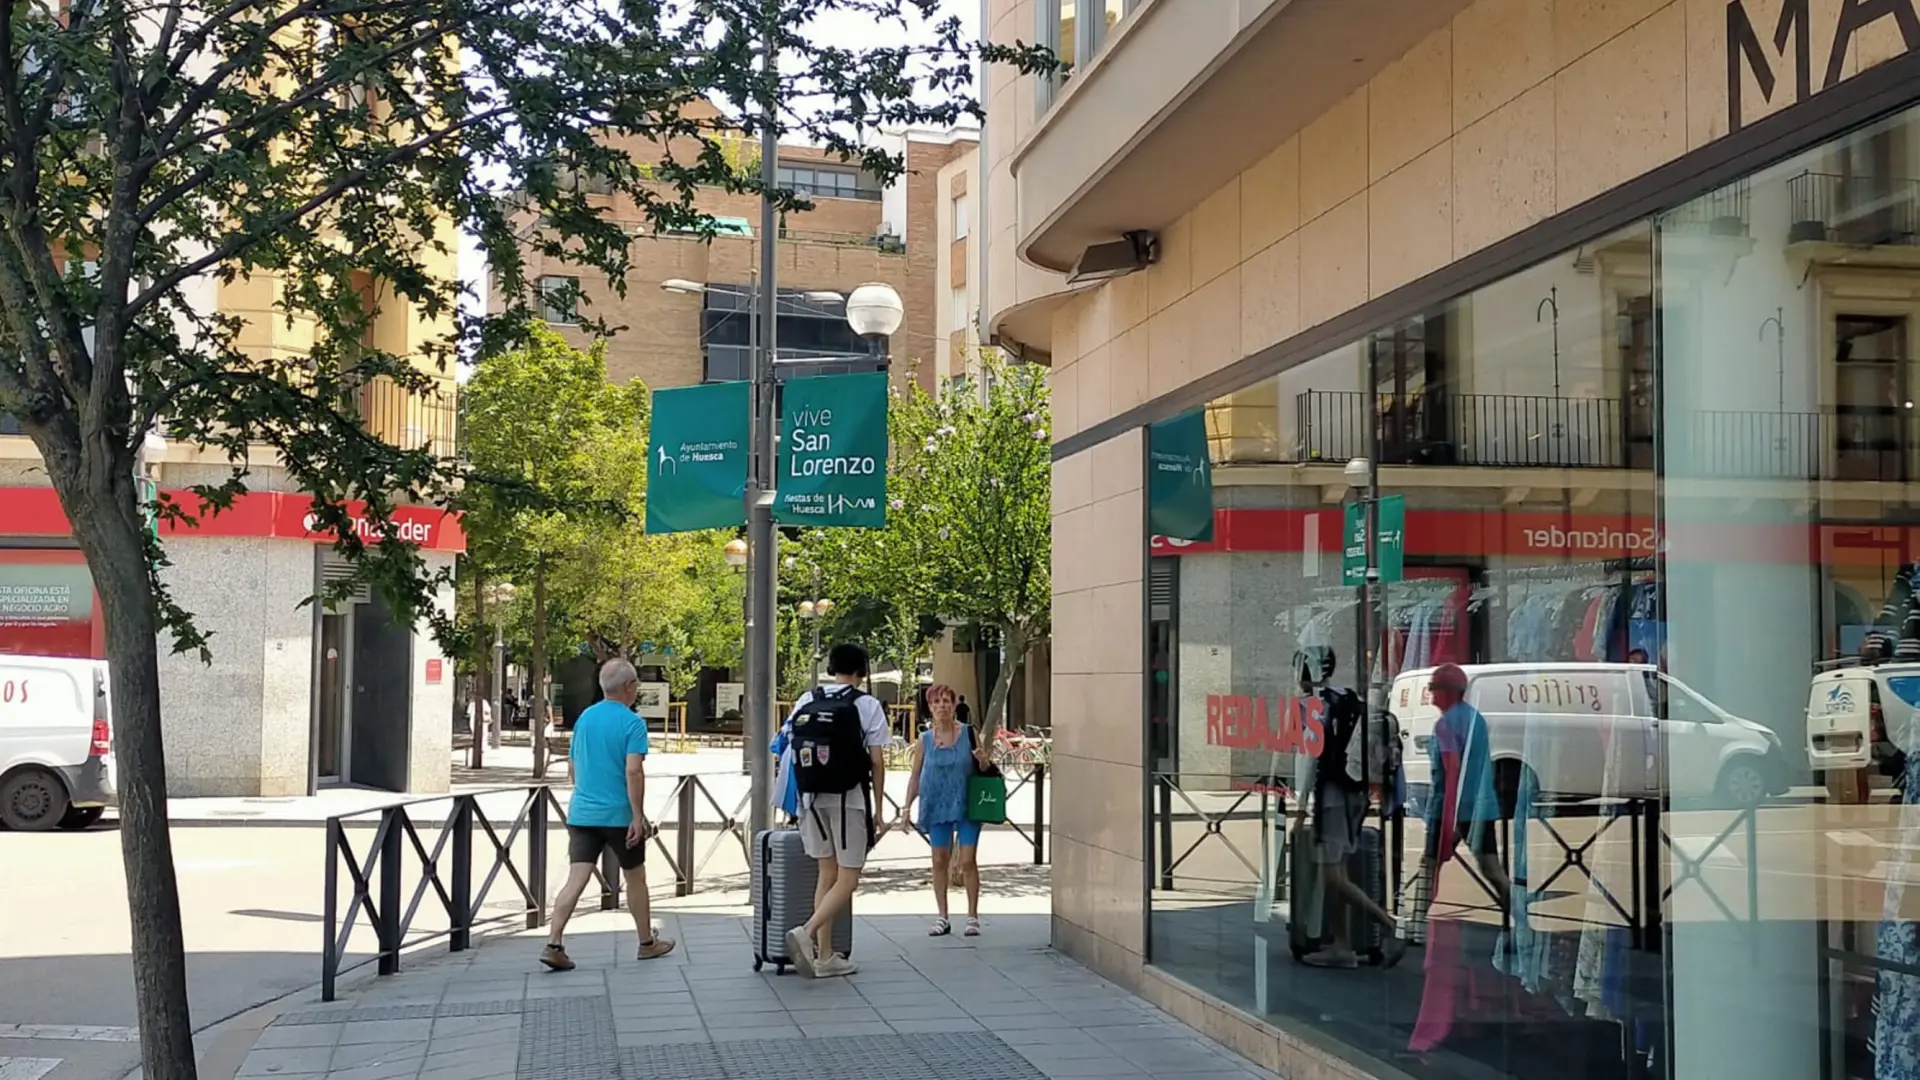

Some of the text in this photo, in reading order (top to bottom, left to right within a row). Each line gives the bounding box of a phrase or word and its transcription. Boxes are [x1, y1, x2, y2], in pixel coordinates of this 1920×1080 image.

[792, 404, 832, 427] vive
[791, 429, 830, 451] San
[680, 441, 737, 453] Ayuntamiento
[680, 452, 724, 461] de Huesca
[791, 454, 875, 477] Lorenzo
[784, 493, 825, 503] fiestas de
[792, 504, 825, 514] Huesca
[13, 586, 49, 595] OFICINA
[58, 595, 69, 603] EN
[3, 604, 68, 612] NEGOCIO AGRO
[1206, 694, 1325, 758] REBAJAS
